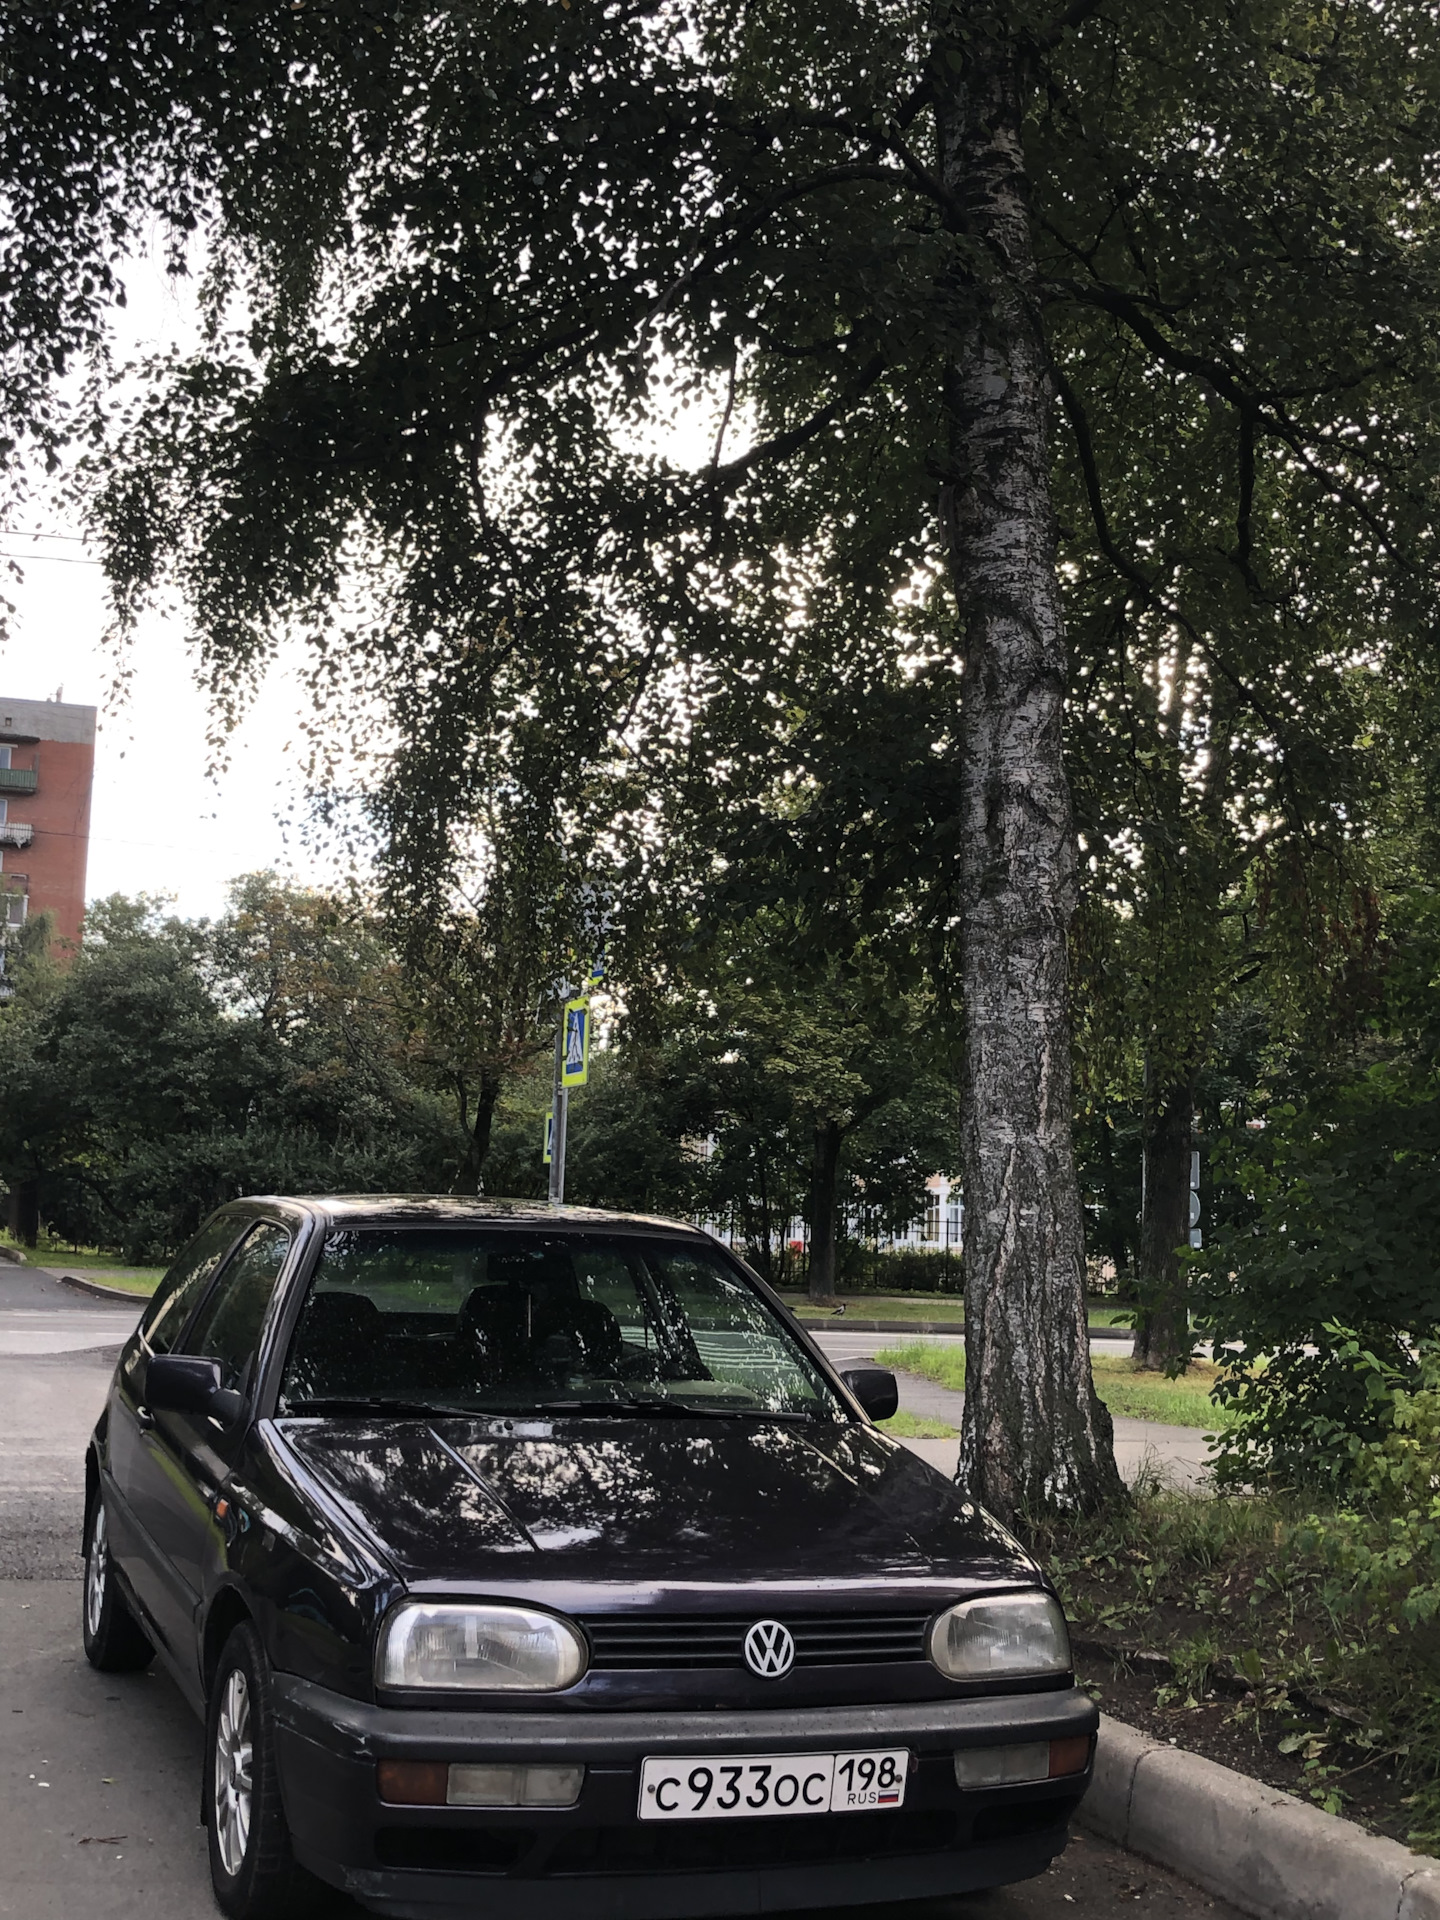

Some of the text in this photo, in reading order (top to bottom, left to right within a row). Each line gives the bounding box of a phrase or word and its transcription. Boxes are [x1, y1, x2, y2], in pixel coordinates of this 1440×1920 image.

[745, 1620, 794, 1677] VW
[838, 1757, 896, 1791] 198
[847, 1793, 877, 1805] RUS
